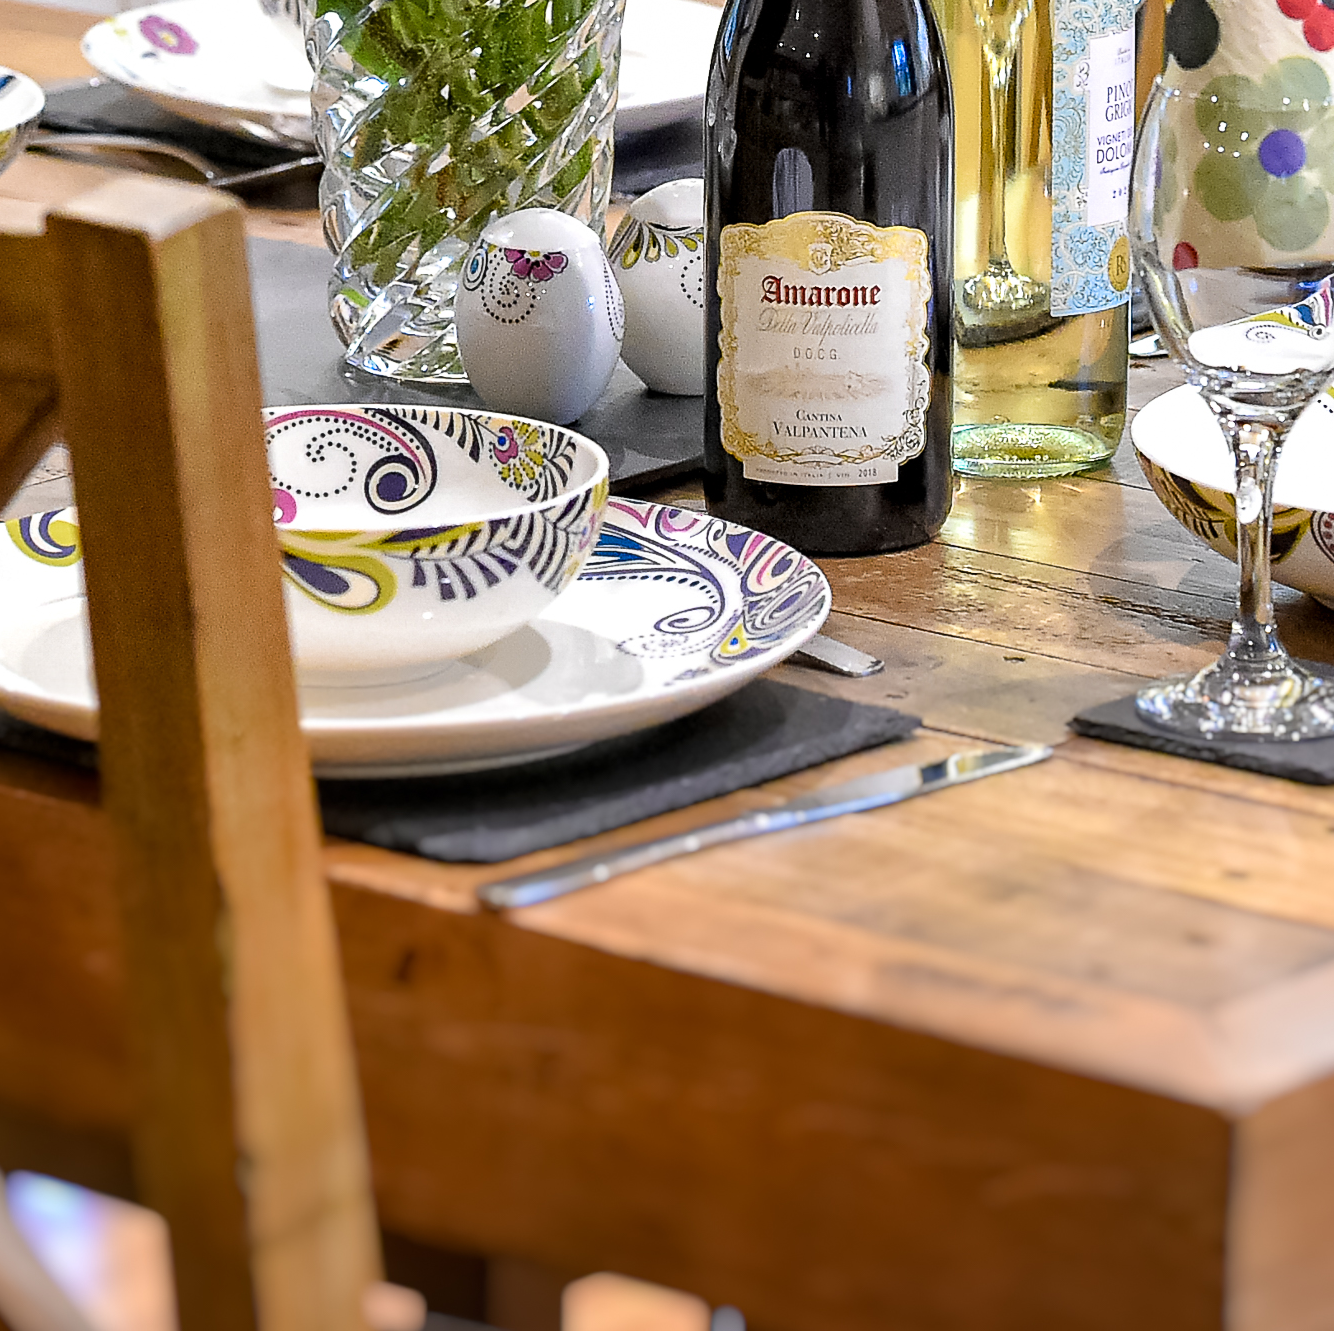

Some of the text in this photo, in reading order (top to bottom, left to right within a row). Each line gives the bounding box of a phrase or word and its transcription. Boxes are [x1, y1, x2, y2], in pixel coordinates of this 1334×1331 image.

[1107, 78, 1133, 103] PINO
[760, 275, 881, 307] Amarone
[772, 421, 868, 439] VALPANTENA
